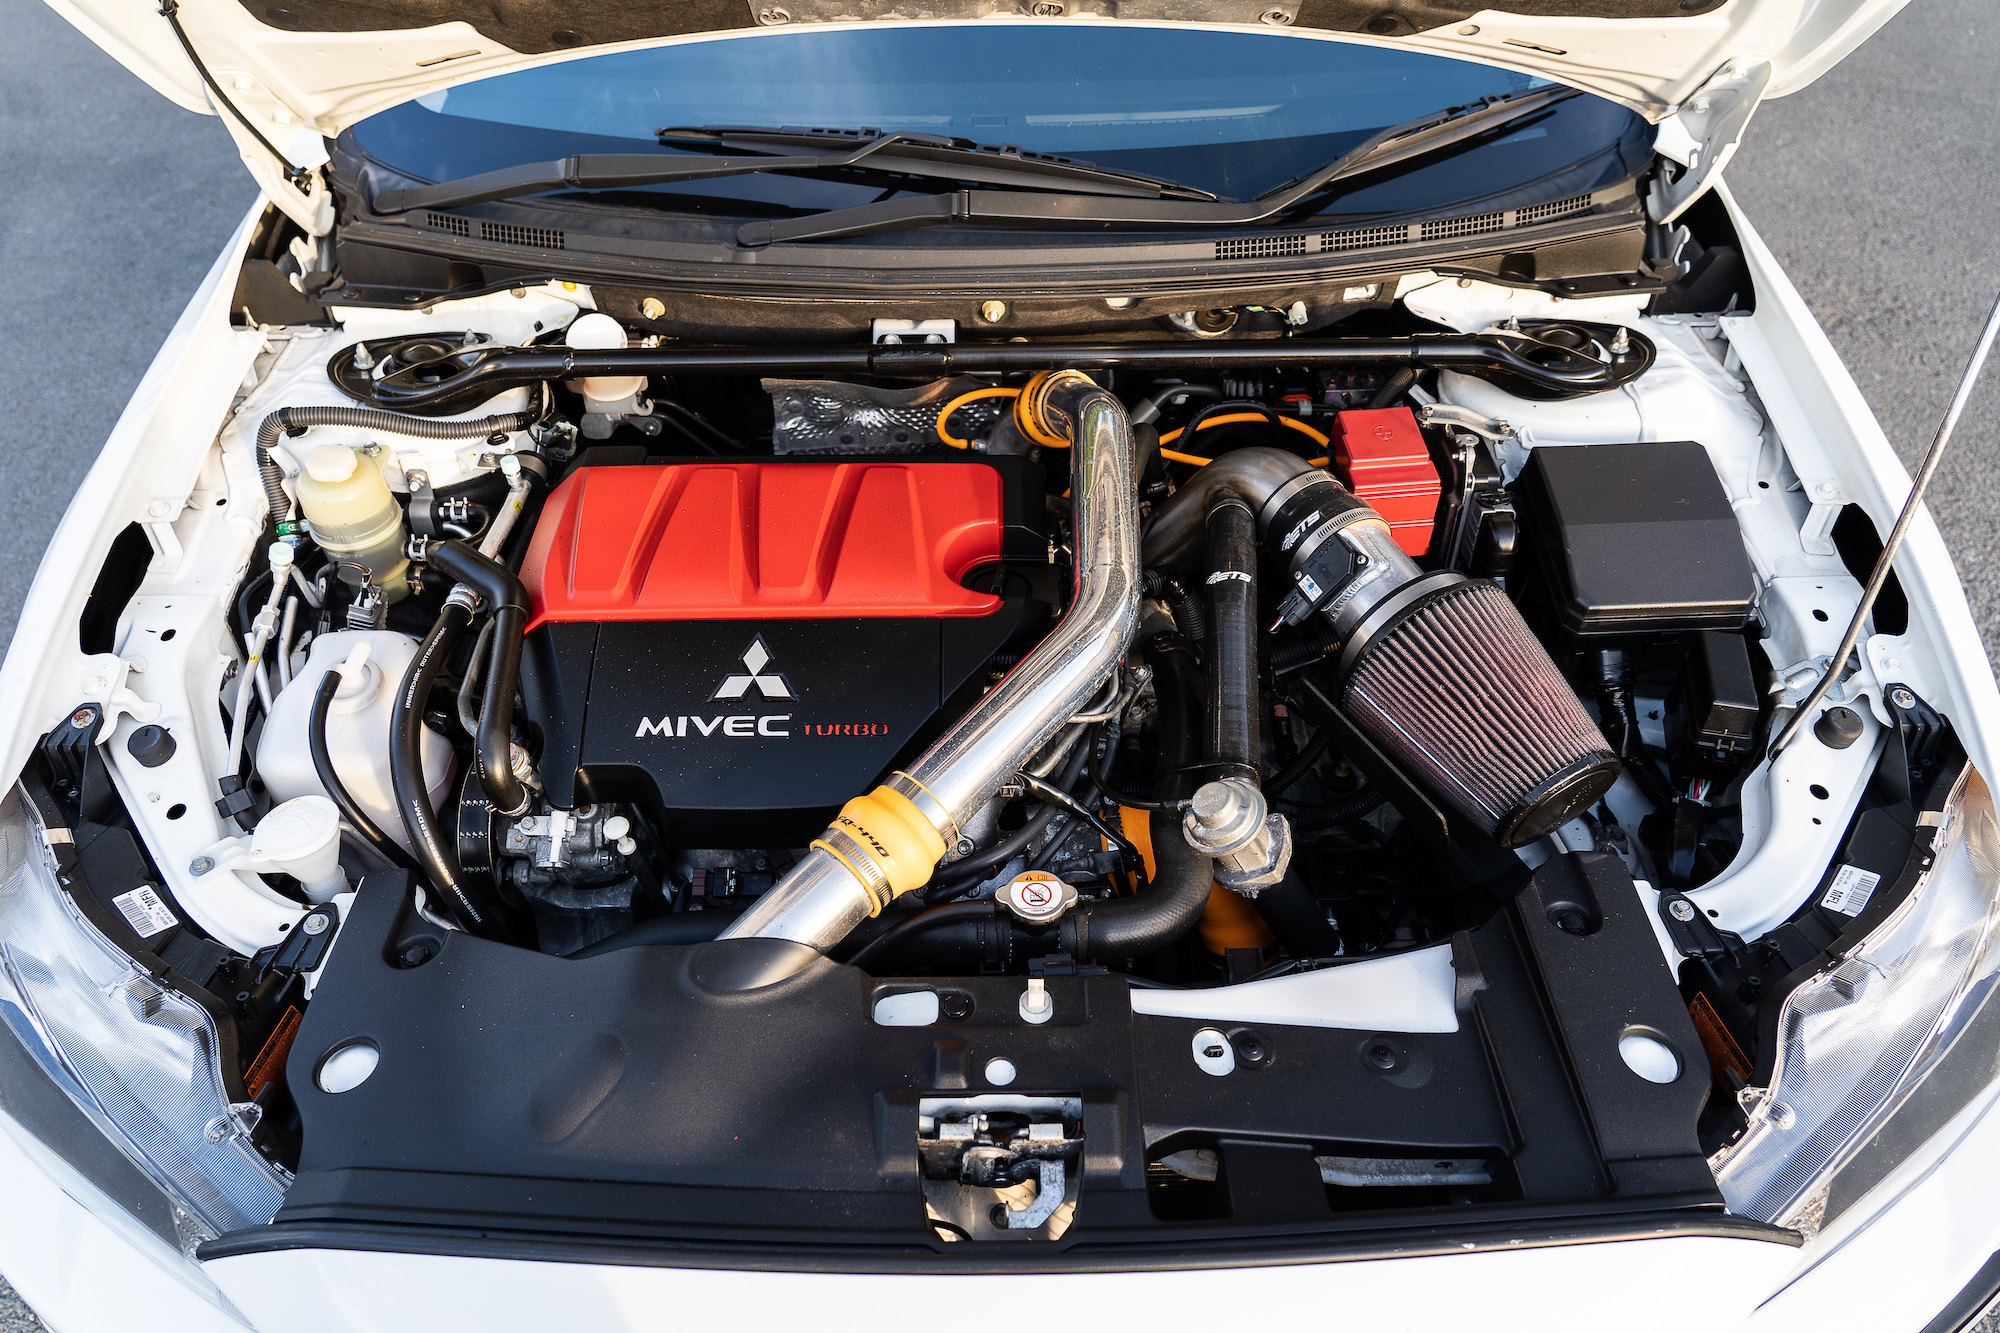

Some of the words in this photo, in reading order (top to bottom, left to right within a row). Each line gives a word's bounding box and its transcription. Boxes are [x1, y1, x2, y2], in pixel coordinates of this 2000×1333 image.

[1216, 570, 1253, 583] ETS
[634, 715, 790, 738] MIVEC
[804, 724, 889, 736] TURBO
